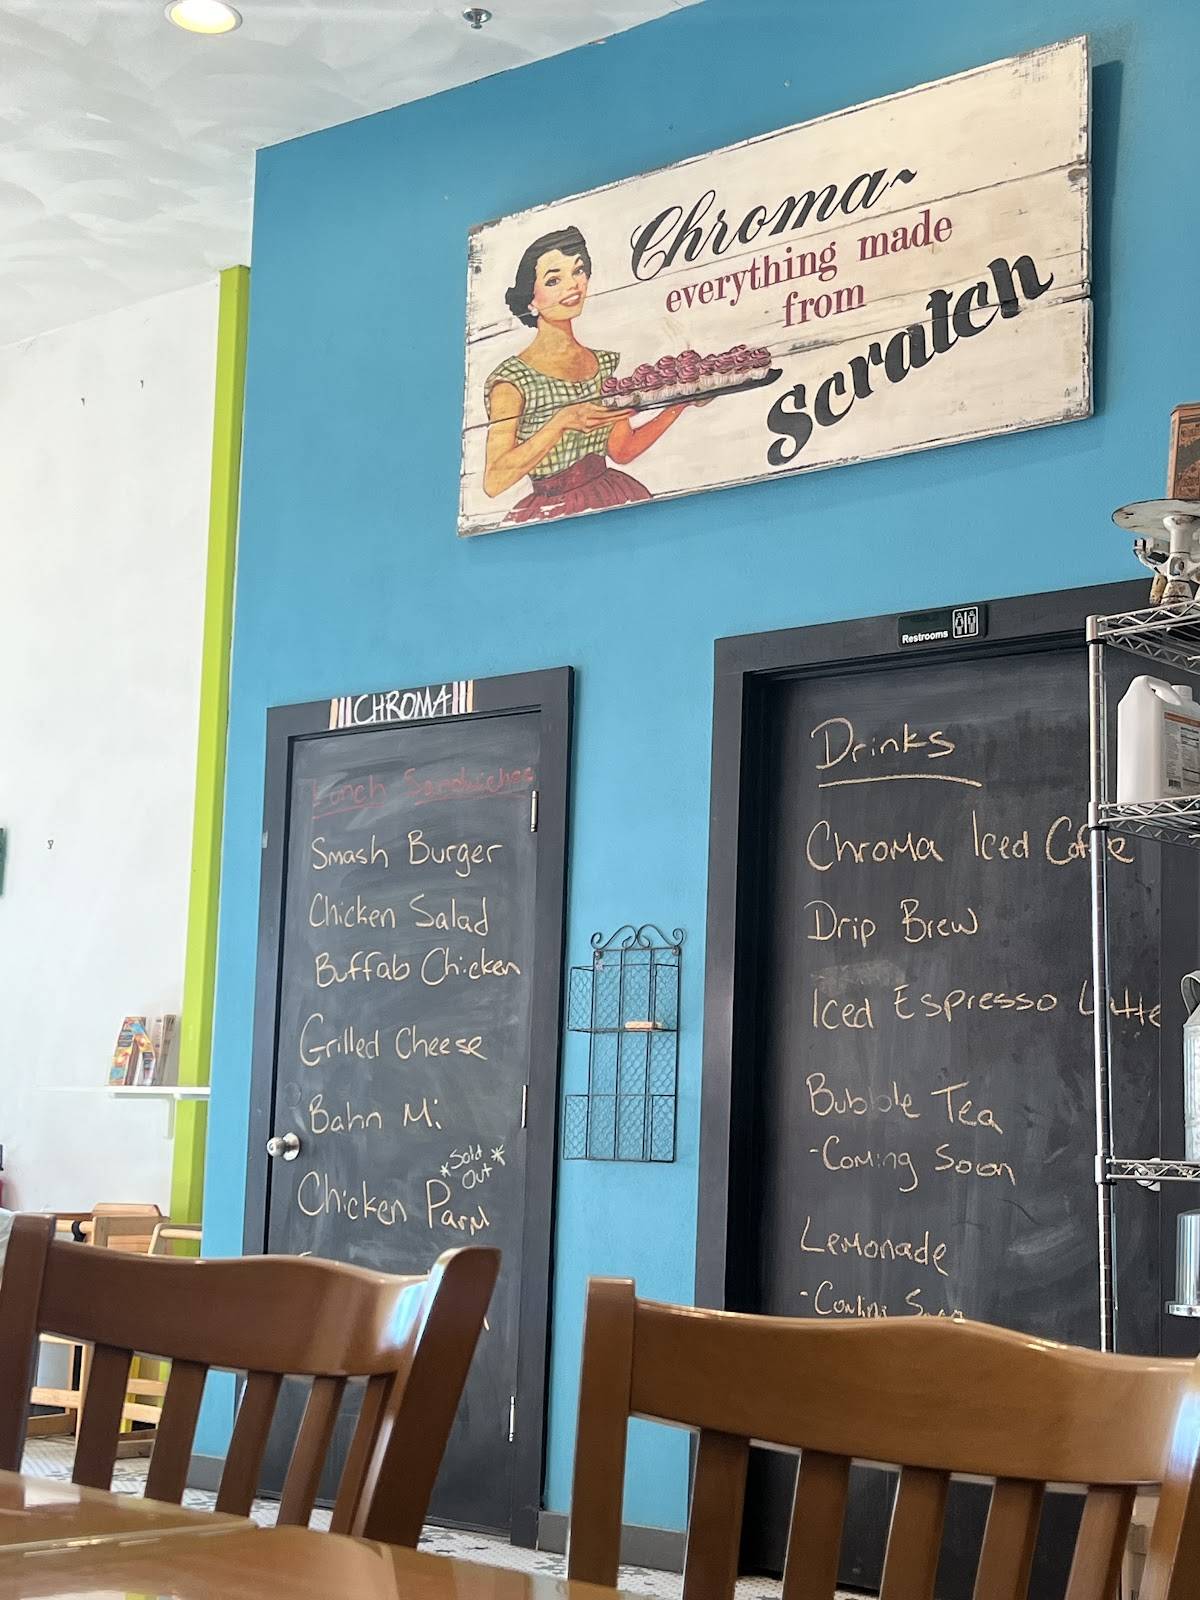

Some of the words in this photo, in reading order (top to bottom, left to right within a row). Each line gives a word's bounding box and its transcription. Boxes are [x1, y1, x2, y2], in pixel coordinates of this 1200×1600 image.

[665, 241, 837, 313] everything
[858, 209, 953, 259] made
[781, 284, 866, 329] from
[767, 254, 1053, 466] Scratch
[902, 630, 948, 644] Restrooms
[354, 685, 451, 724] CHROMA
[810, 717, 956, 770] Drinks
[311, 835, 389, 870] Smash
[408, 830, 503, 878] Burger
[972, 810, 1029, 860] Iced
[1045, 815, 1136, 866] Cofe
[309, 893, 396, 929] Chicken
[409, 893, 489, 936] Salad
[804, 901, 876, 947] Drip
[900, 898, 979, 943] Brew
[421, 947, 521, 985] Chicken
[813, 988, 874, 1029] Iced
[893, 984, 1057, 1022] Espresso
[300, 1013, 379, 1067] Grilled
[396, 1025, 488, 1060] Cheese
[309, 1094, 382, 1134] Bahn
[404, 1098, 442, 1130] Mi
[806, 1072, 921, 1119] Bubble
[931, 1081, 1003, 1134] Tea
[935, 1143, 1016, 1185] Soon
[298, 1171, 407, 1225] Chicken
[426, 1179, 490, 1236] Parm
